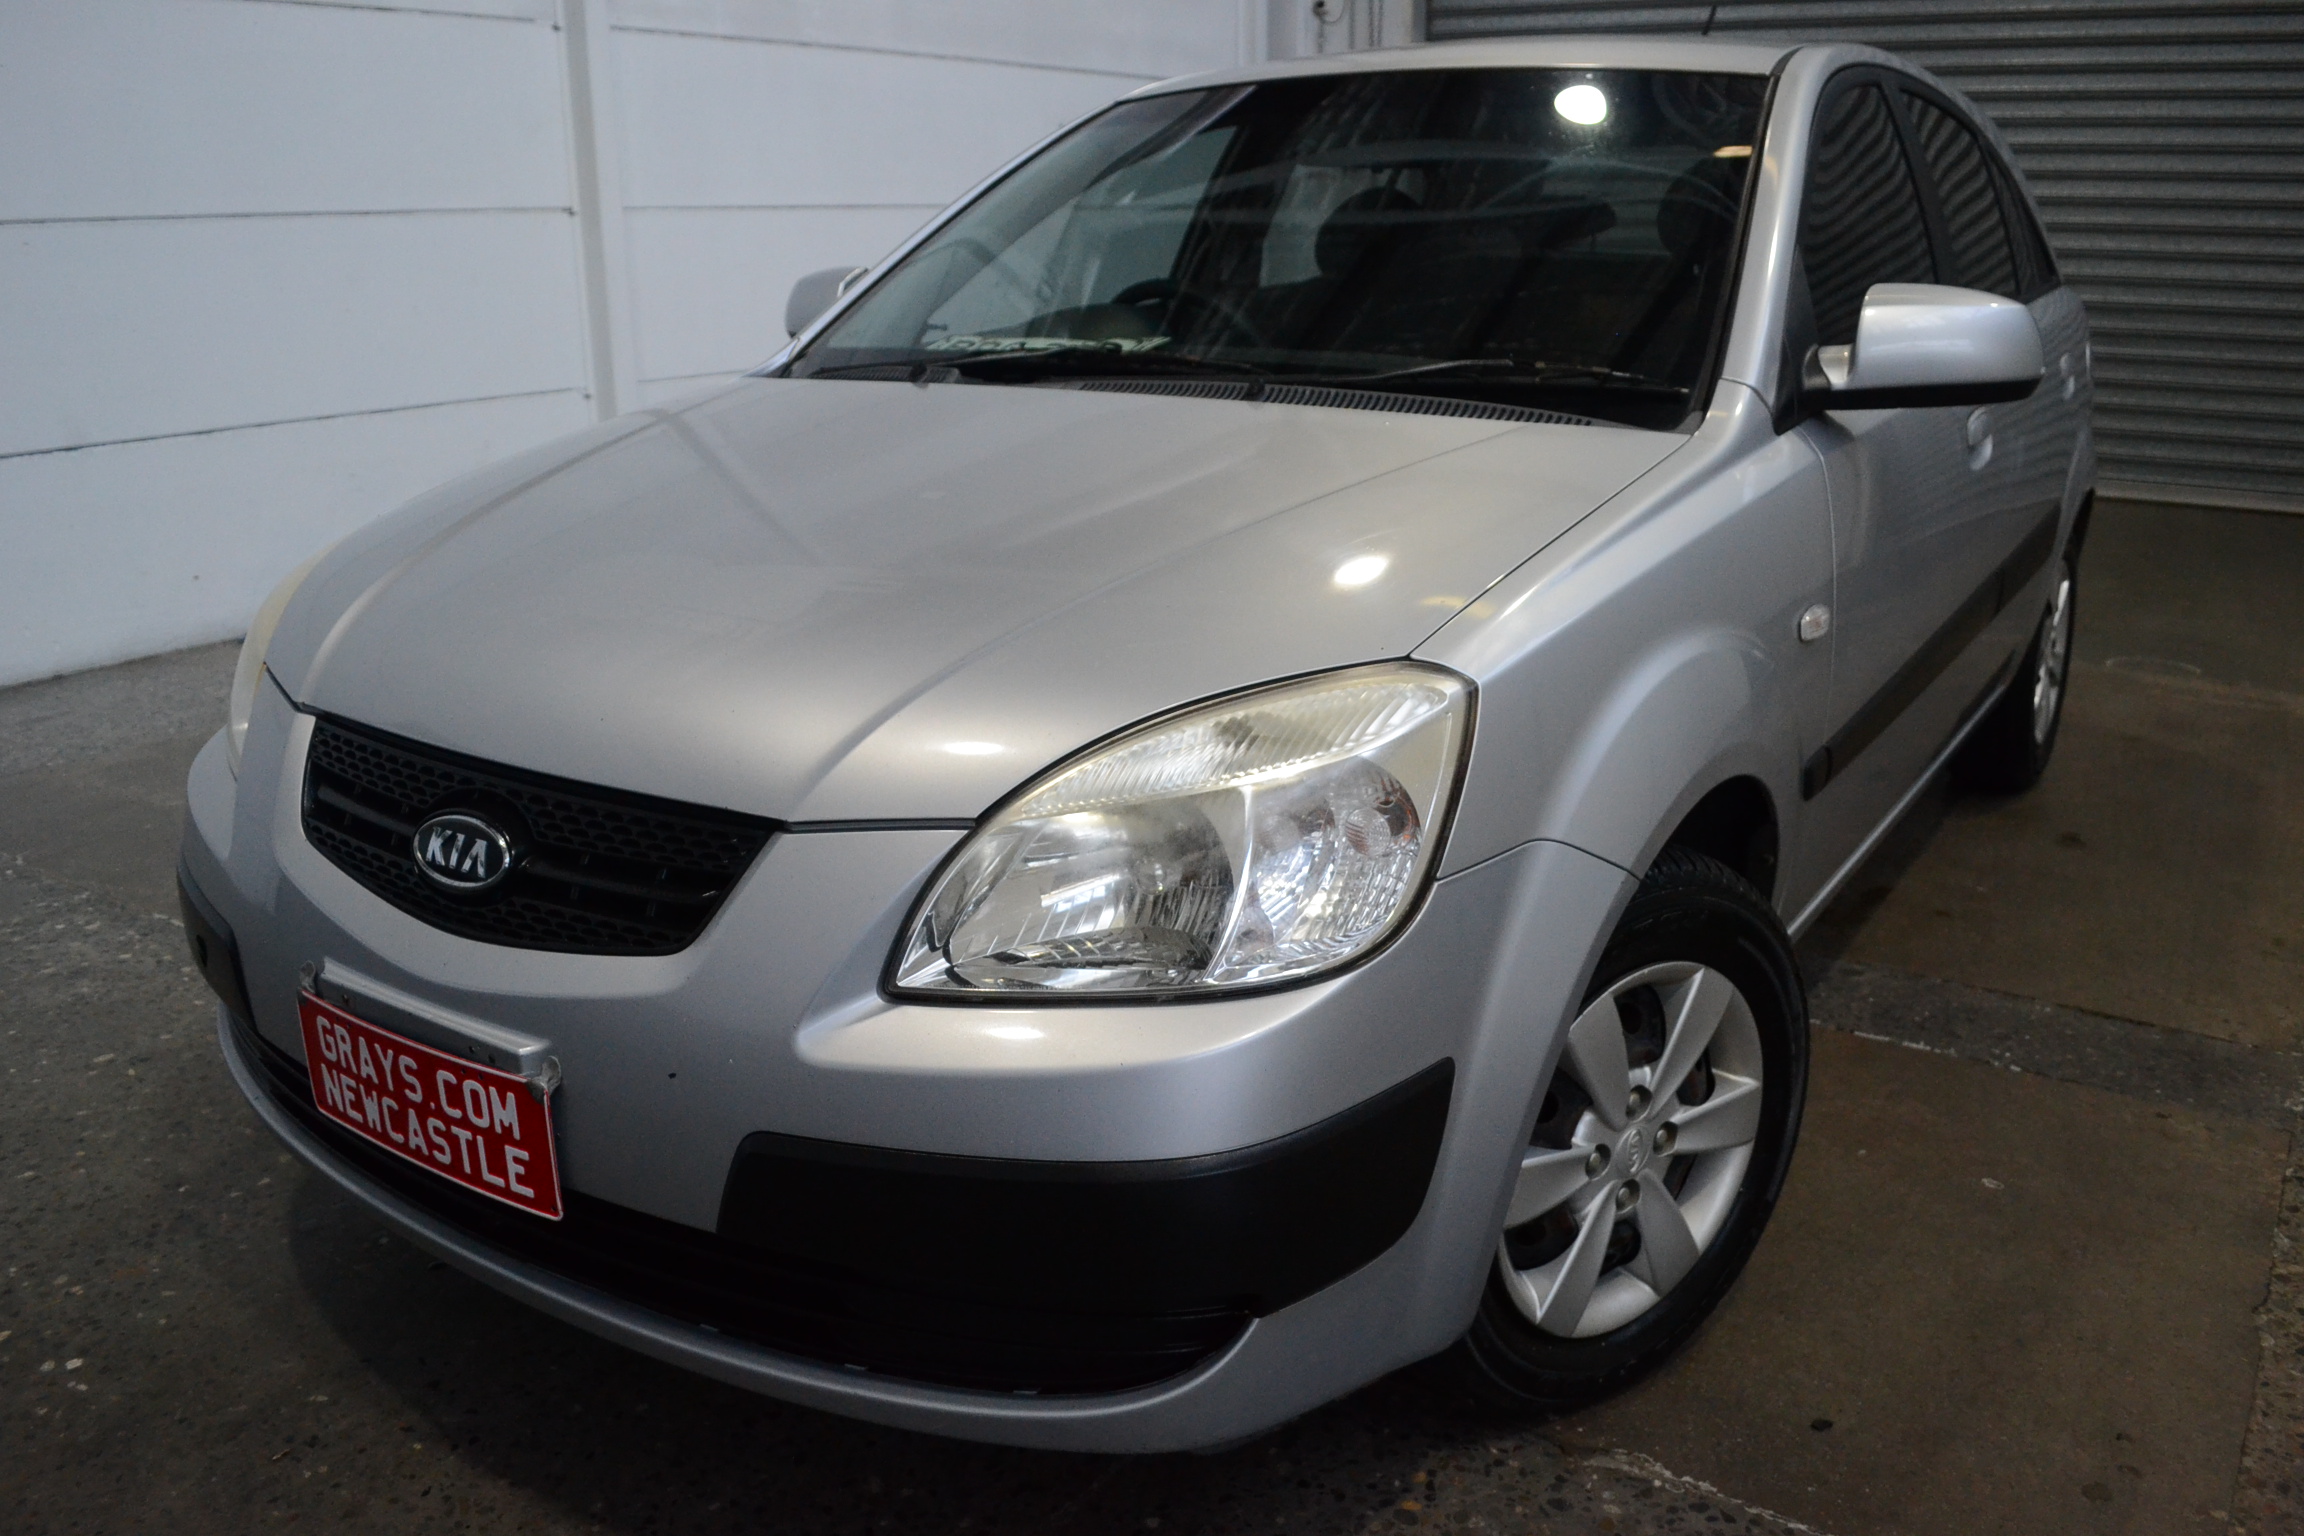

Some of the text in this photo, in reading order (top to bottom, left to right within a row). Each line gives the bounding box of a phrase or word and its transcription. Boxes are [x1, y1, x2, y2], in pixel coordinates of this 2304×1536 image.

[425, 826, 488, 878] KIA
[316, 1015, 521, 1140] GRAYS.COM
[321, 1063, 535, 1199] NEWCASTLE
